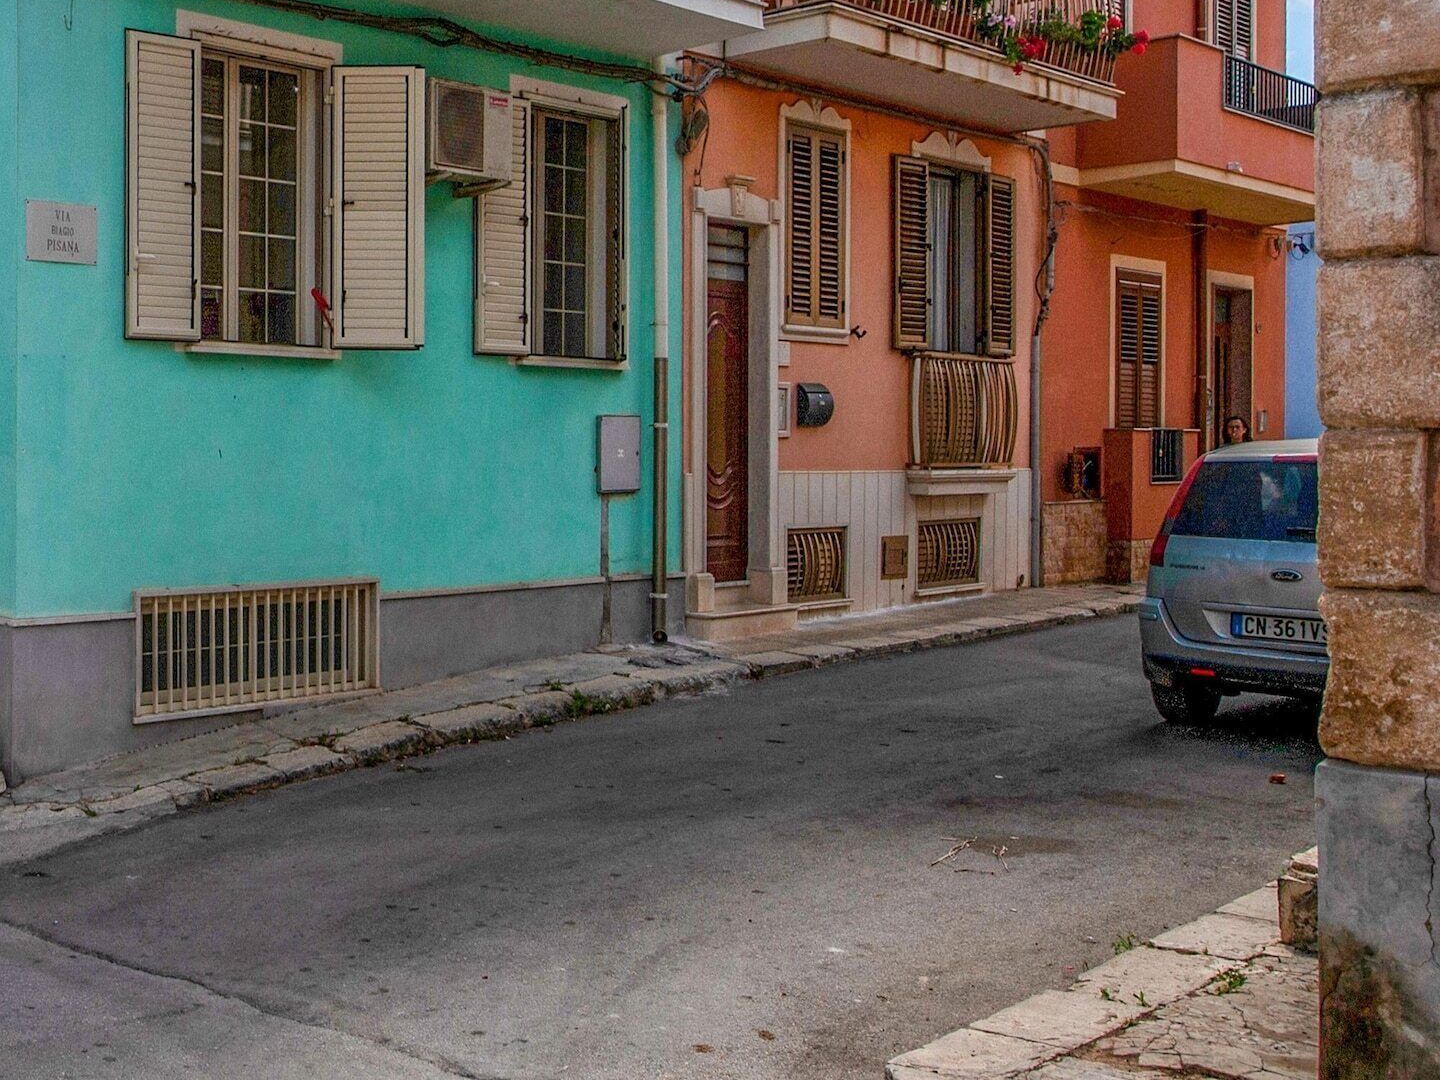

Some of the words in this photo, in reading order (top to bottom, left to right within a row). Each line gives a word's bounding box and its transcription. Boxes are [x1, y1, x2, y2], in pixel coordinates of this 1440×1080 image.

[55, 209, 71, 222] VIA
[51, 225, 75, 237] BIAGIO
[46, 238, 80, 253] PISANA
[1244, 616, 1267, 637] CN
